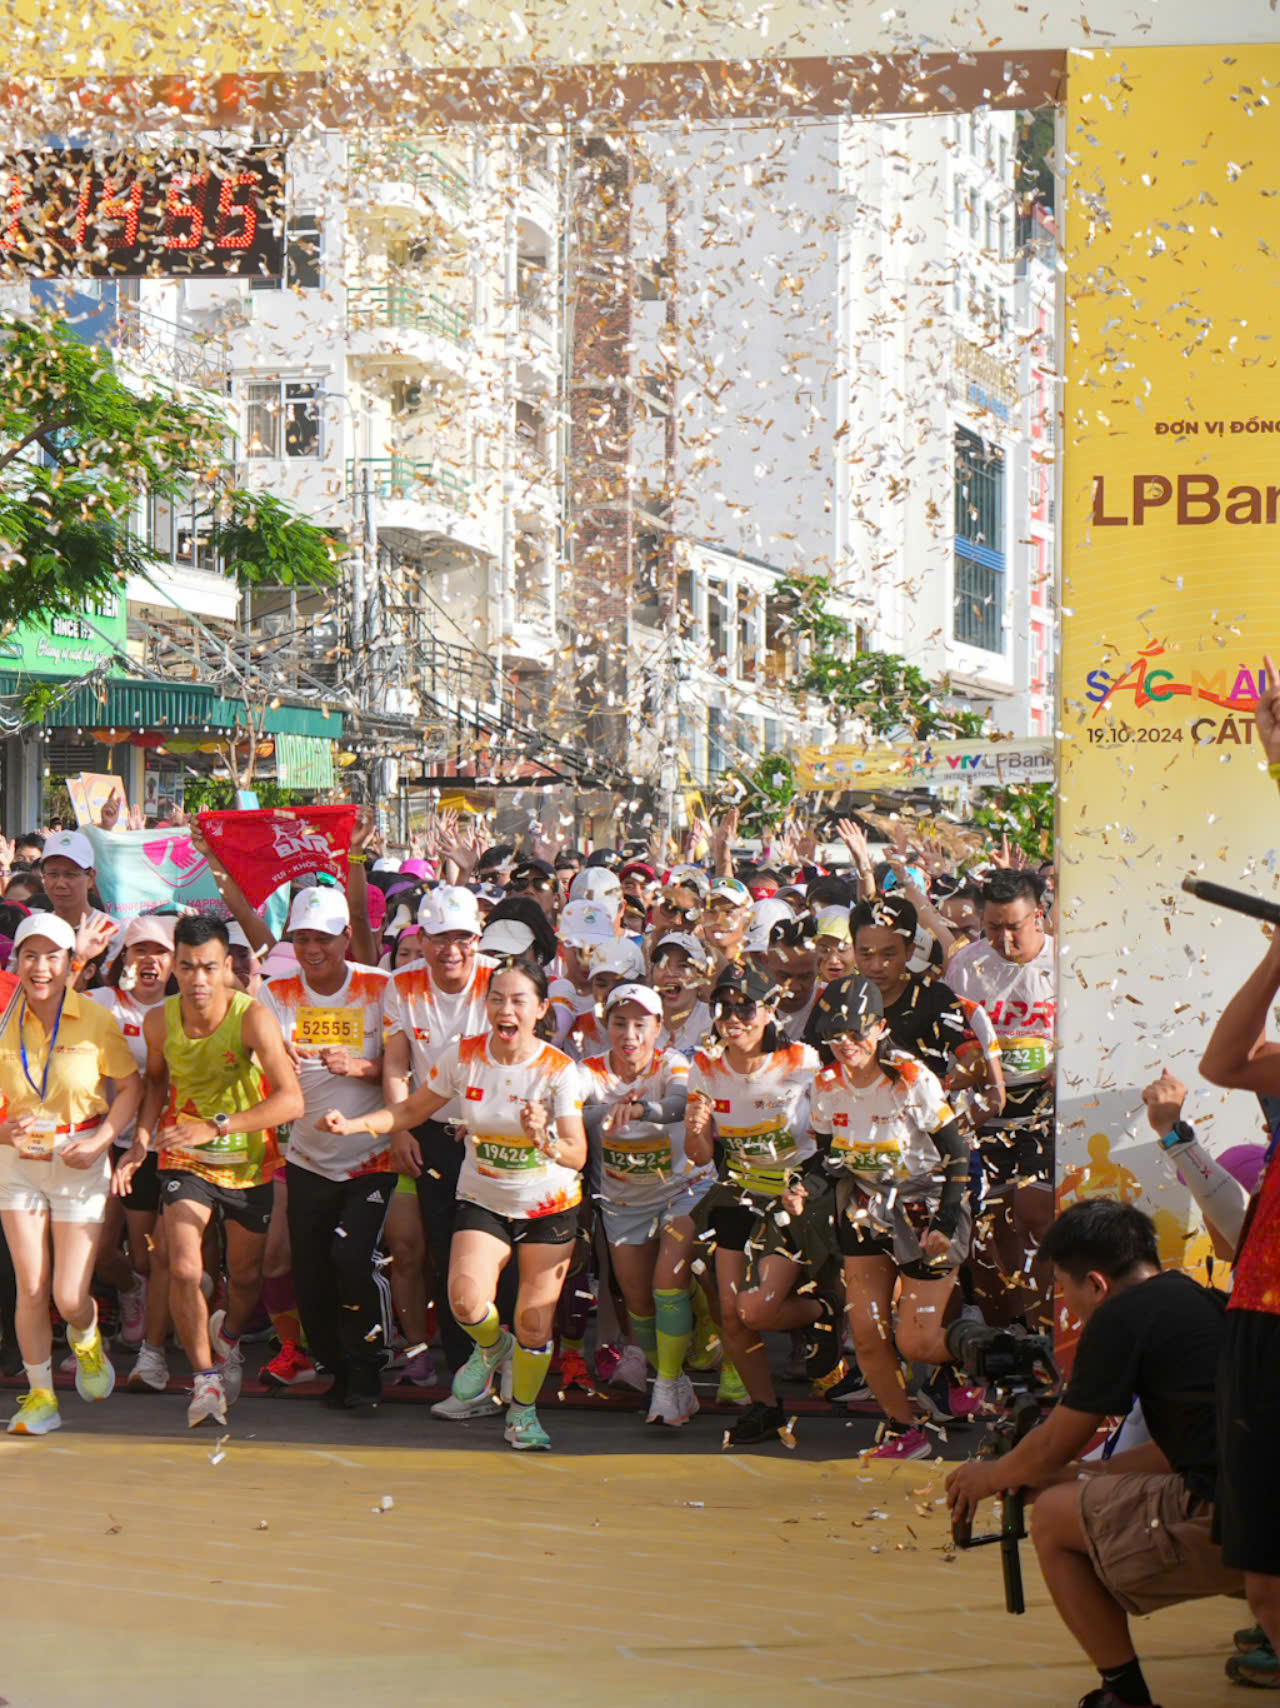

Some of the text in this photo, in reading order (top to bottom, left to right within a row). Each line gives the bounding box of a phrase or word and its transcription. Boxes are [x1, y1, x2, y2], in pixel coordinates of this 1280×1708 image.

[1155, 419, 1198, 435] ĐƠN
[1204, 421, 1224, 437] VỊ
[1088, 713, 1257, 745] 19.10.2024 CÁT
[303, 1020, 351, 1036] 52555
[483, 1143, 528, 1162] 19426
[609, 1151, 658, 1166] 1252
